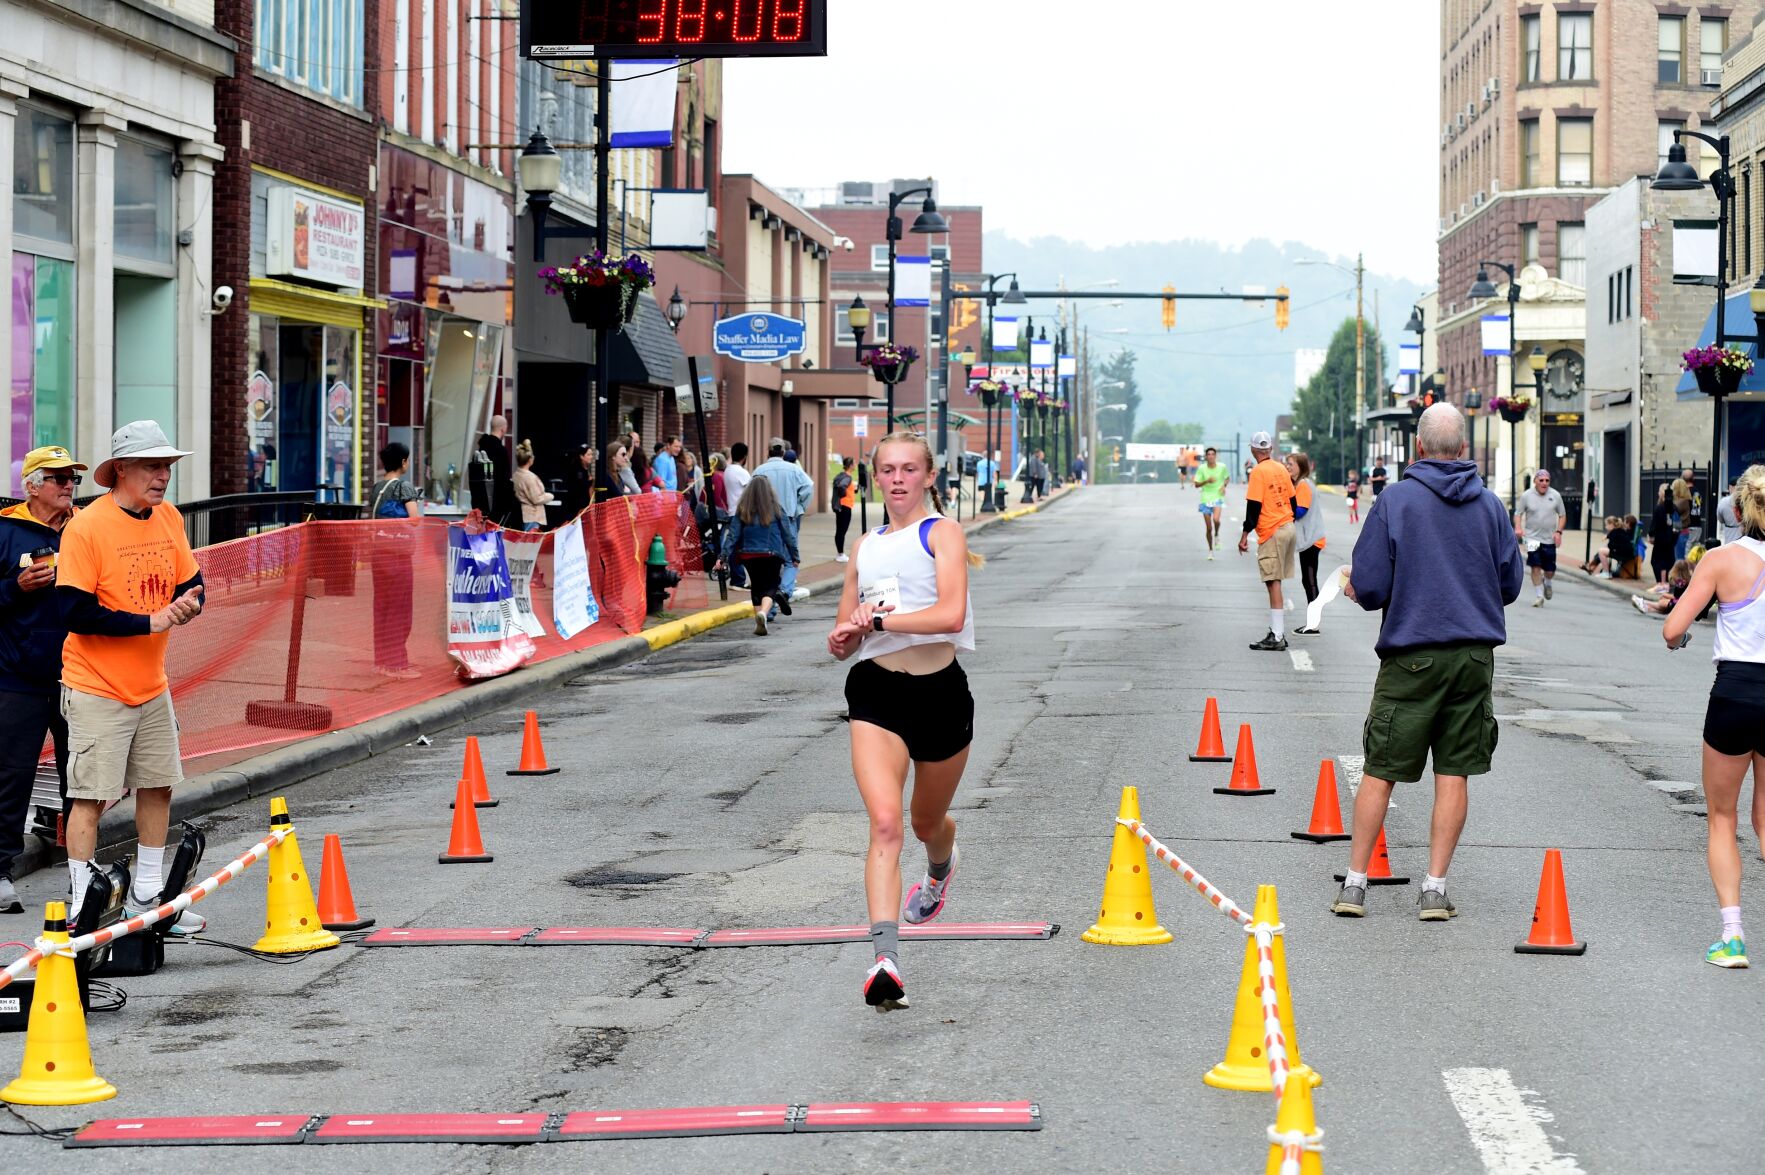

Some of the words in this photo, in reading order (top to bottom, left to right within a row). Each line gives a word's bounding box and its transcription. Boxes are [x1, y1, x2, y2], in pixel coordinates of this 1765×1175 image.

[313, 203, 347, 234] JOHNNY
[313, 229, 358, 250] RESTAURANT
[718, 334, 749, 344] Shaffer
[750, 334, 778, 344] Madia
[779, 334, 800, 344] Law
